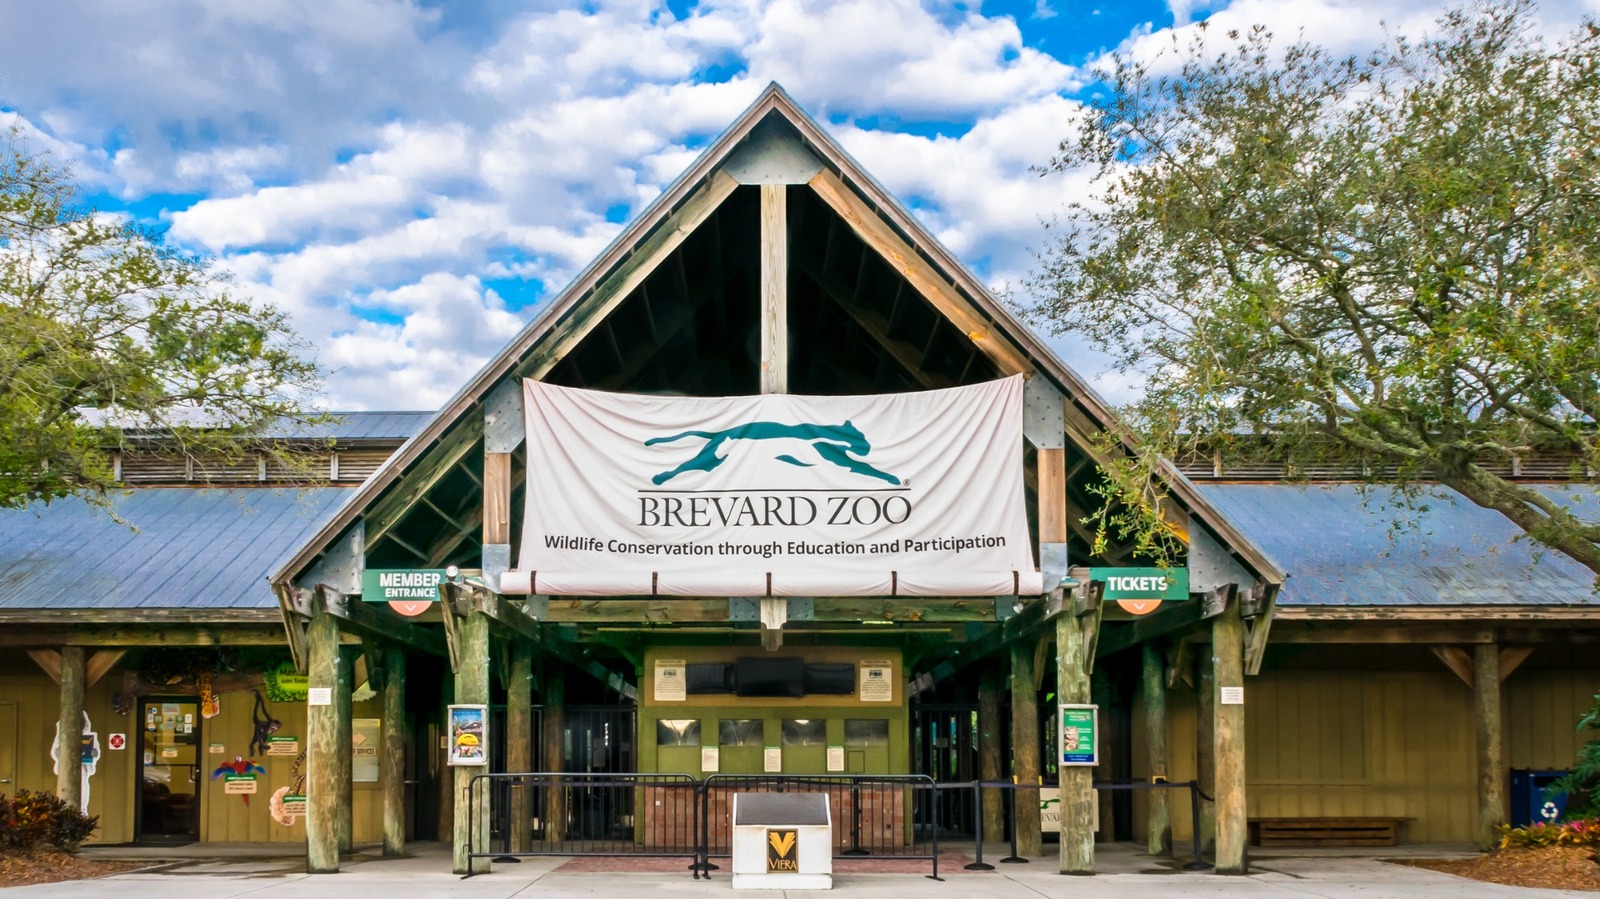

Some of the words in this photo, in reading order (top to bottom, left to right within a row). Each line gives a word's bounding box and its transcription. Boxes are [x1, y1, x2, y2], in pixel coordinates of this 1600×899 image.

[638, 496, 817, 527] BREVARD
[827, 495, 912, 526] ZOO
[544, 535, 604, 552] Wildlife
[607, 539, 714, 556] Conservation
[717, 541, 783, 558] through
[787, 540, 865, 555] Education
[869, 539, 900, 554] and
[904, 534, 1006, 554] Participation
[380, 573, 441, 587] MEMBER
[1107, 576, 1168, 591] TICKETS
[385, 588, 436, 598] ENTRANCE
[769, 858, 797, 870] VIERA
